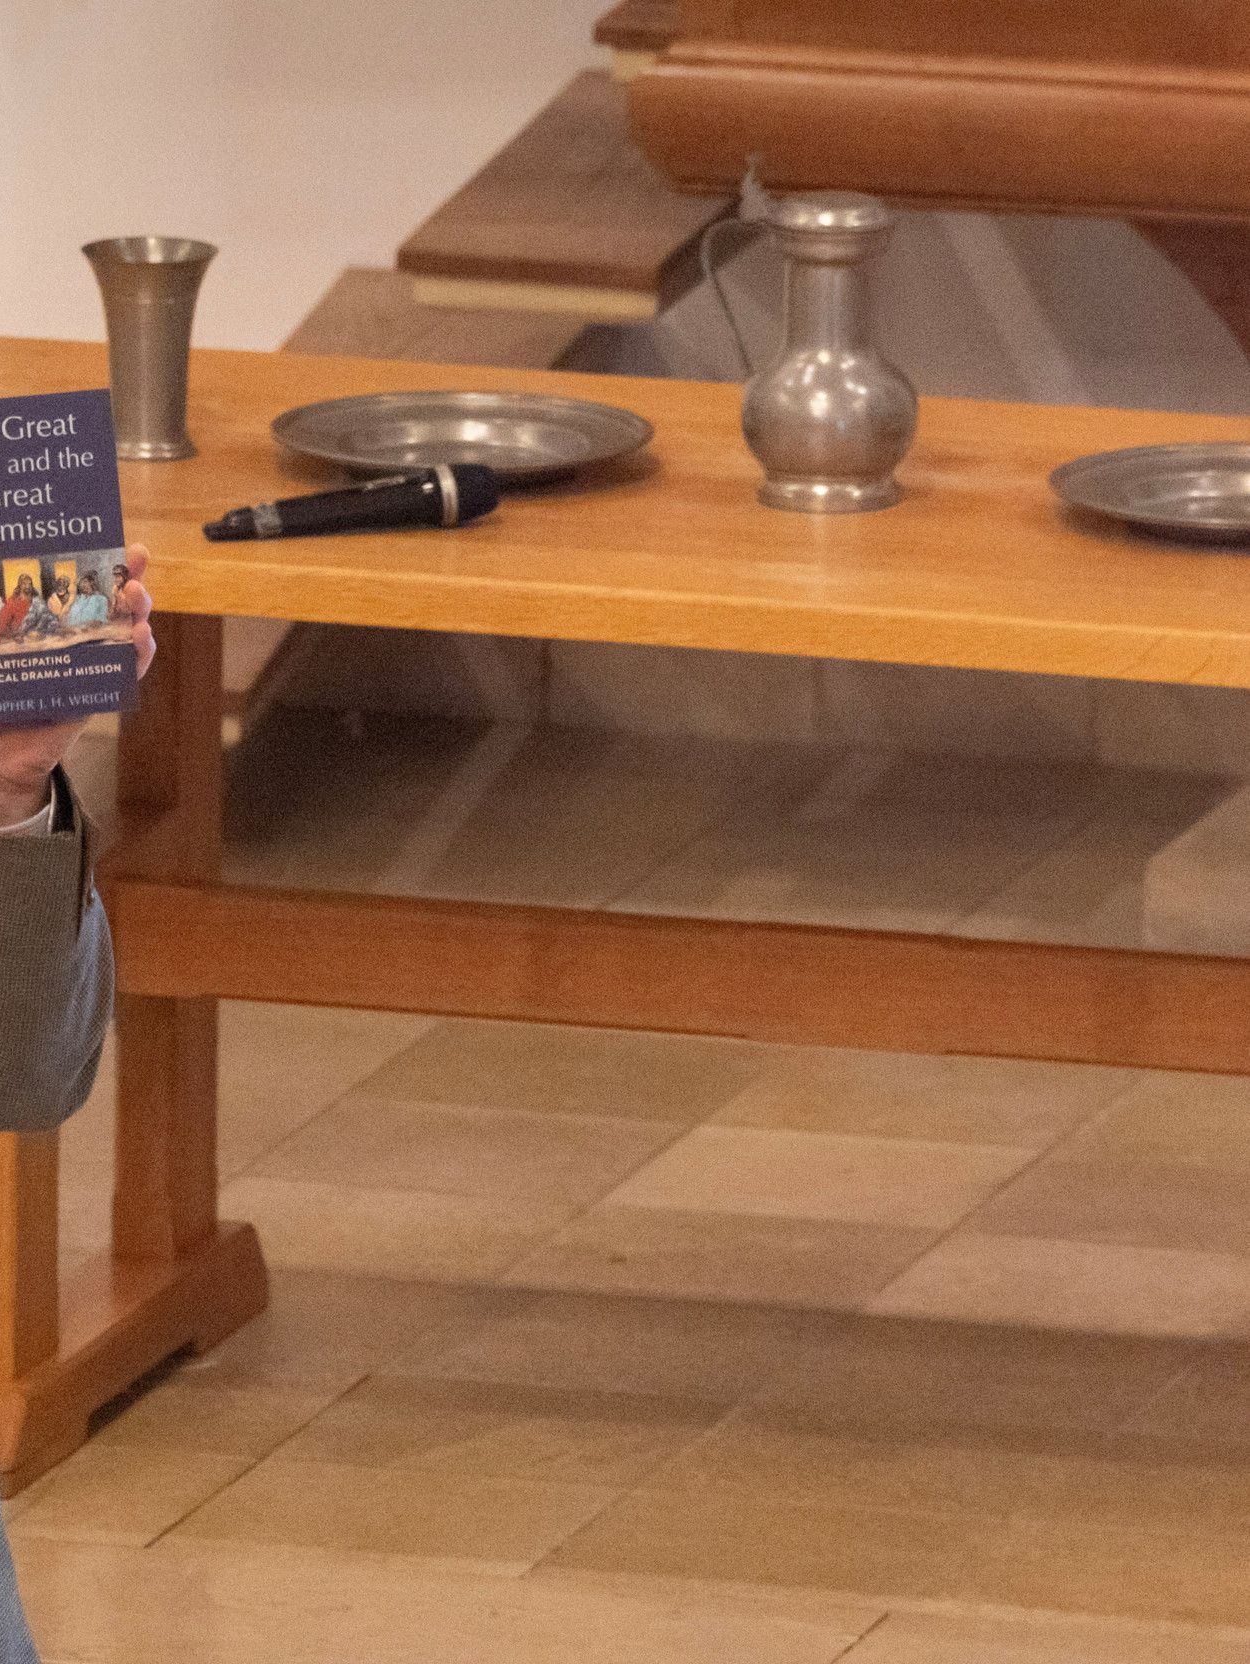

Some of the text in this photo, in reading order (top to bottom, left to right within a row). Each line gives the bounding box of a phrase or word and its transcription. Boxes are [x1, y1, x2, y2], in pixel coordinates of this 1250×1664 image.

[1, 413, 78, 441] Great
[7, 449, 50, 474] and
[57, 446, 95, 469] the
[21, 668, 61, 682] DRAMA
[62, 667, 73, 677] of
[75, 663, 122, 676] MISSION
[51, 696, 64, 708] H.
[68, 691, 121, 706] WRIGHT
